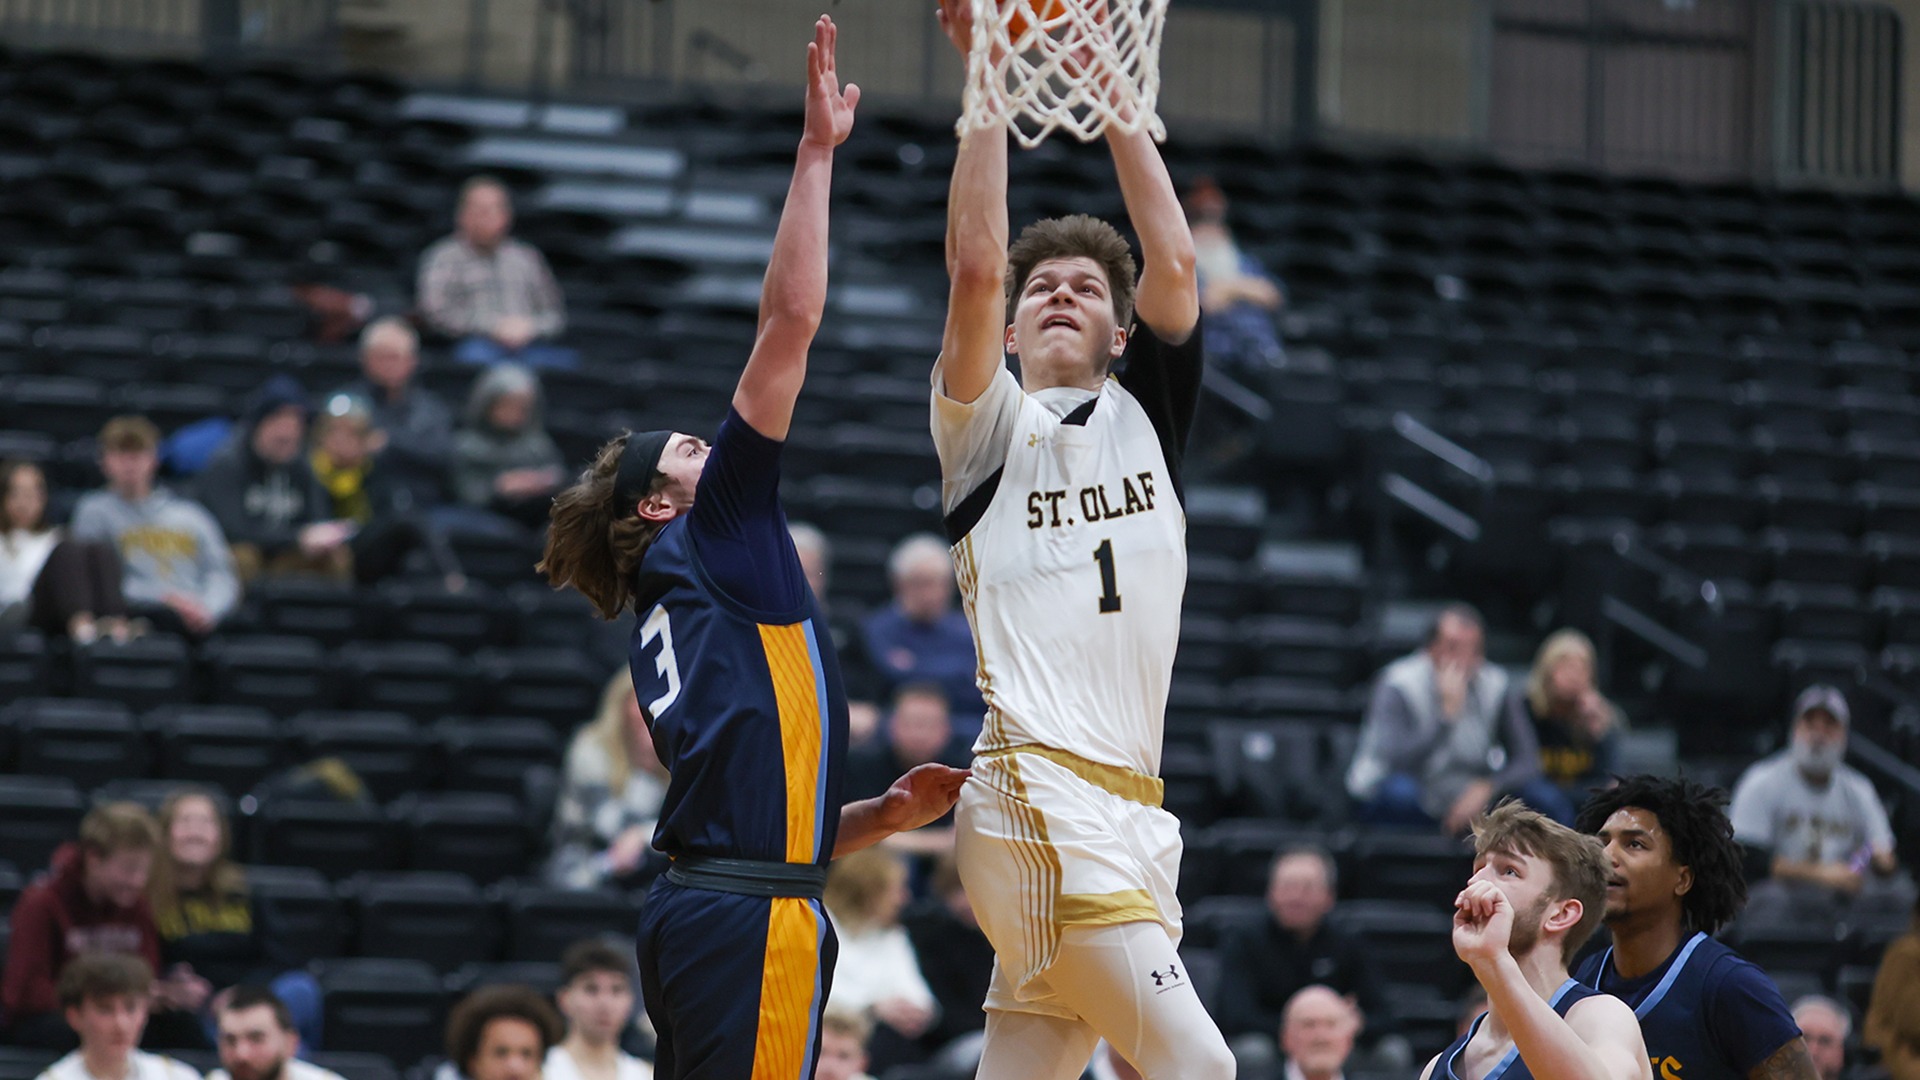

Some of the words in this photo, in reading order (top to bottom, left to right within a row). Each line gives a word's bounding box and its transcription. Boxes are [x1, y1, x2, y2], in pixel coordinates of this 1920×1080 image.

[1027, 490, 1075, 530] ST.
[1079, 471, 1156, 523] OLAF
[1092, 537, 1122, 614] 1
[639, 603, 682, 720] 3
